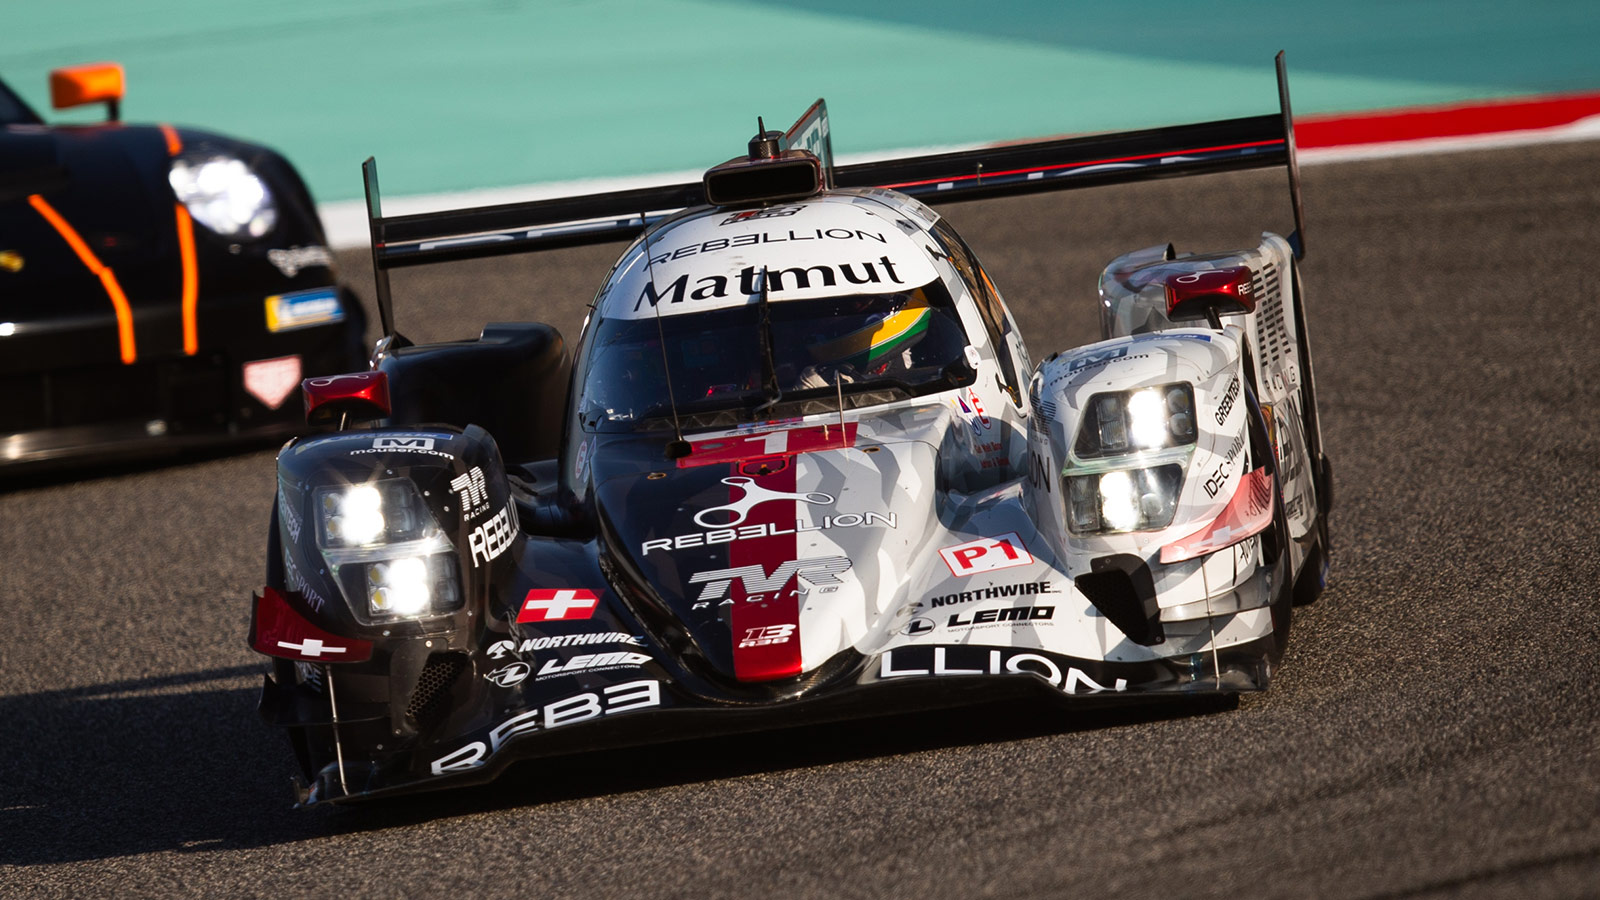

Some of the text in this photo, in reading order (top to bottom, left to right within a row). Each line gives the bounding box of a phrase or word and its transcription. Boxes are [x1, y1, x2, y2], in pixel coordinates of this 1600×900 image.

[633, 256, 905, 313] Matmut
[1050, 354, 1149, 386] mouser.com
[350, 448, 455, 460] mouser.com
[744, 430, 788, 454] 1
[1203, 462, 1230, 500] IDEC
[463, 501, 490, 522] RACING
[953, 538, 1020, 570] P1
[688, 555, 853, 601] TVR
[691, 586, 840, 611] RACING
[931, 581, 1051, 608] NORTHWIRE
[947, 606, 1056, 628] LEMO
[947, 620, 1055, 634] MOTORSPORT CONNECTORS
[518, 632, 649, 653] NORTHWIRE
[535, 665, 641, 682] MOTORSPORT CONNECTORS
[537, 651, 654, 676] LEMO
[881, 647, 1128, 694] LLION
